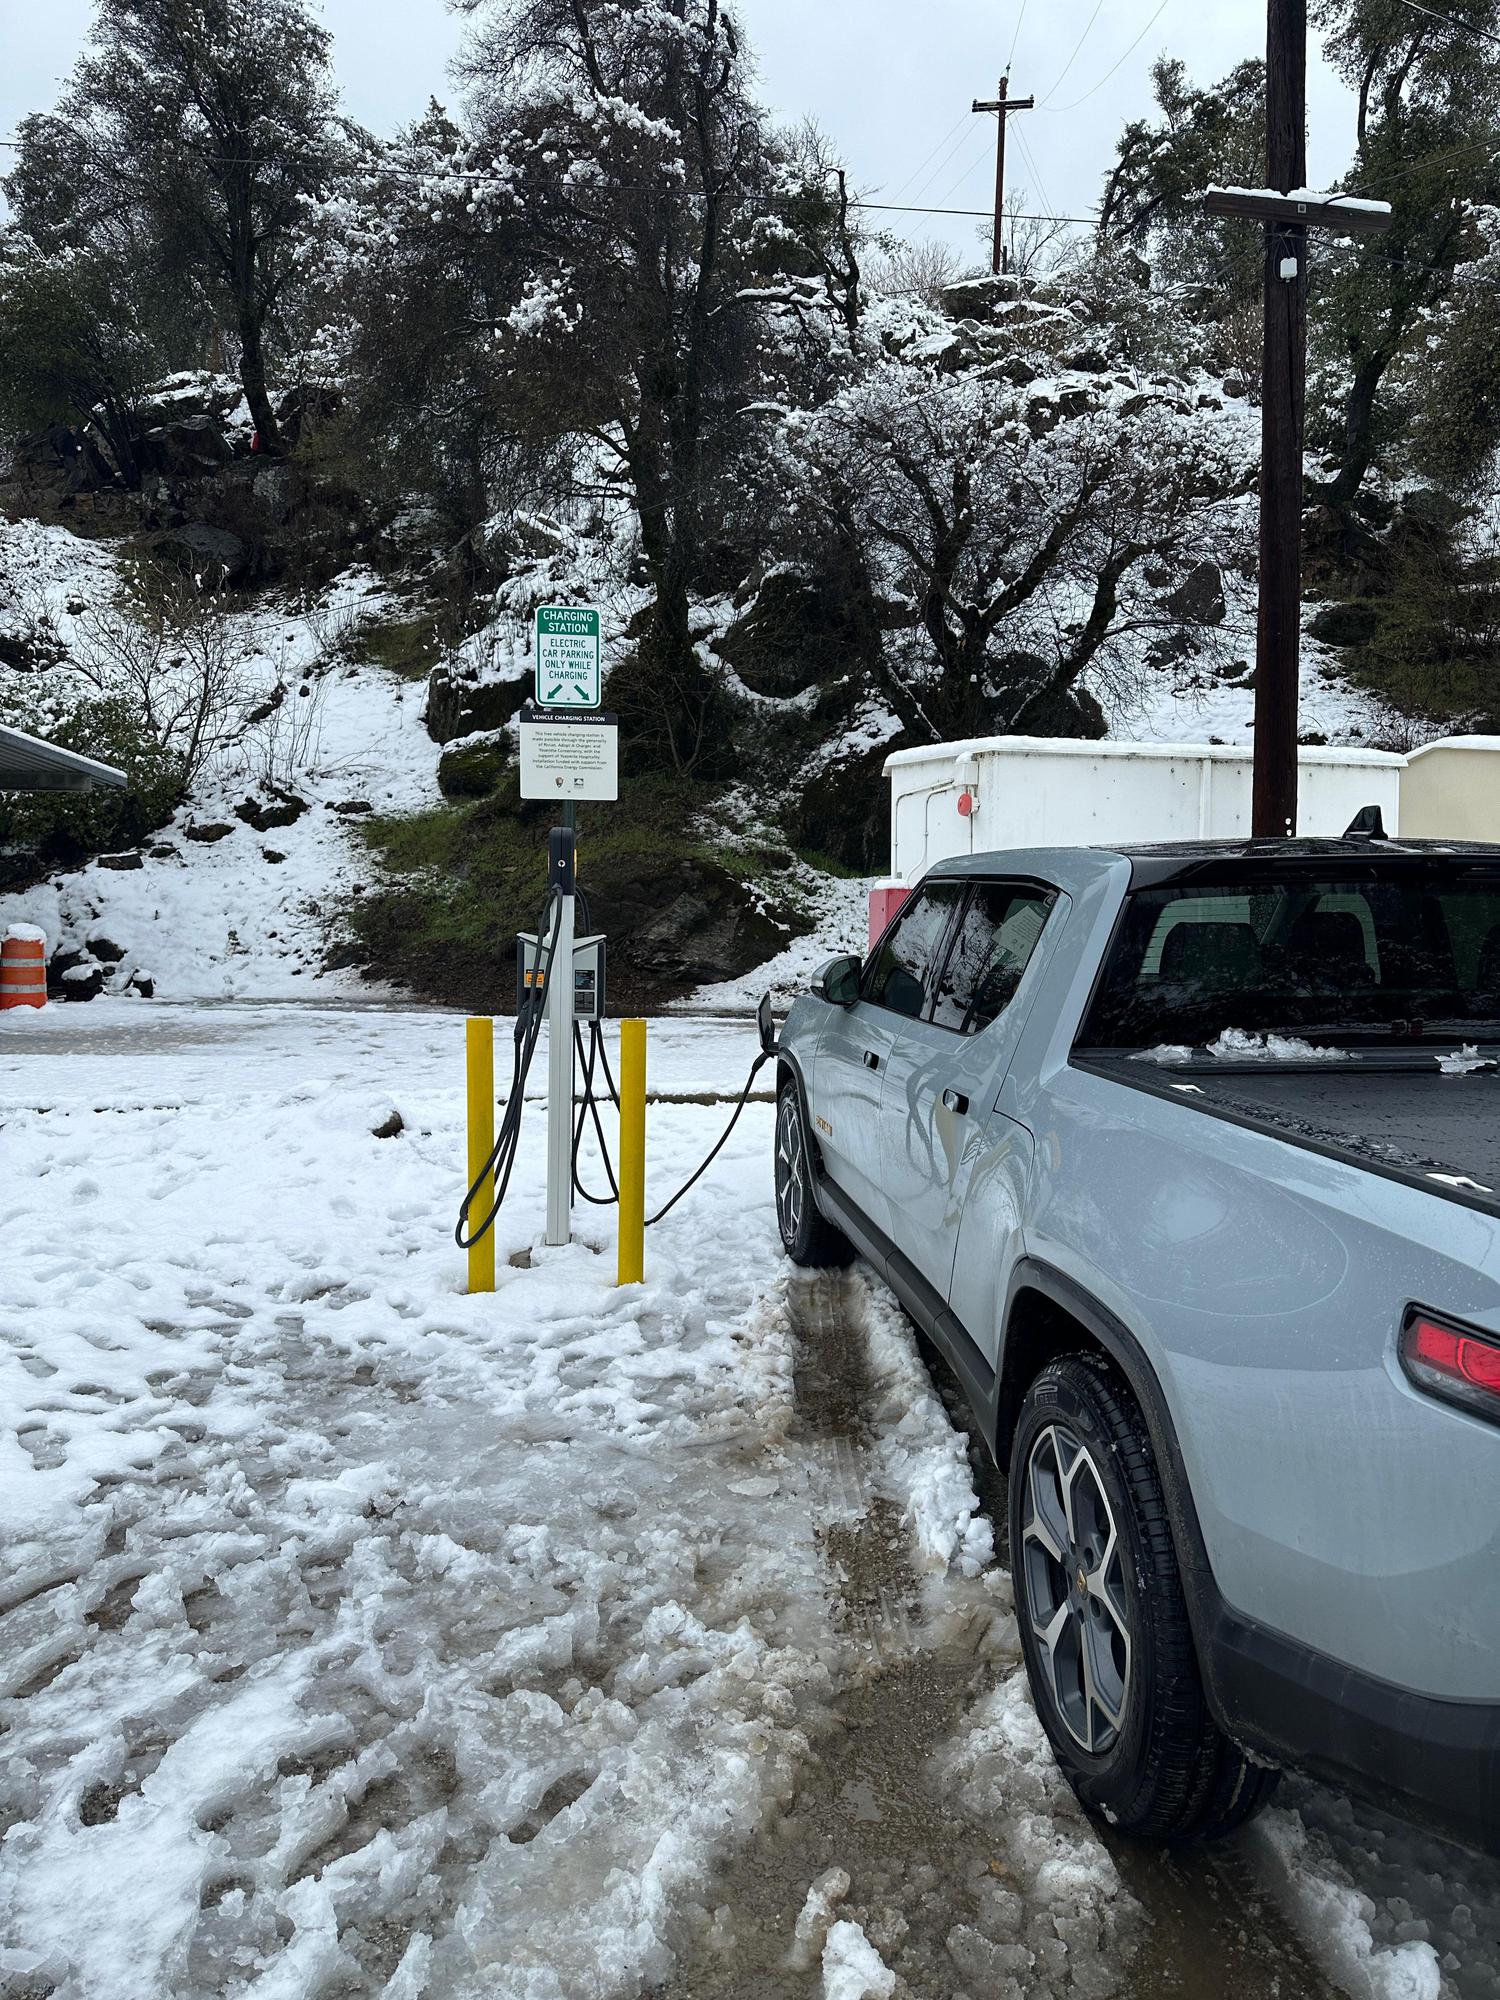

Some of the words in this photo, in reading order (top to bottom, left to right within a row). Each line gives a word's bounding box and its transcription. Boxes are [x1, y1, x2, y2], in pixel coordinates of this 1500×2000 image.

[543, 610, 593, 622] CHARGING
[548, 622, 588, 632] STATION
[550, 638, 586, 648] ELECTRIC
[542, 649, 558, 657] CAR
[560, 650, 594, 659] PARKING
[545, 660, 565, 668] ONLY
[568, 661, 591, 670] WHILE
[549, 671, 588, 680] CHARGING
